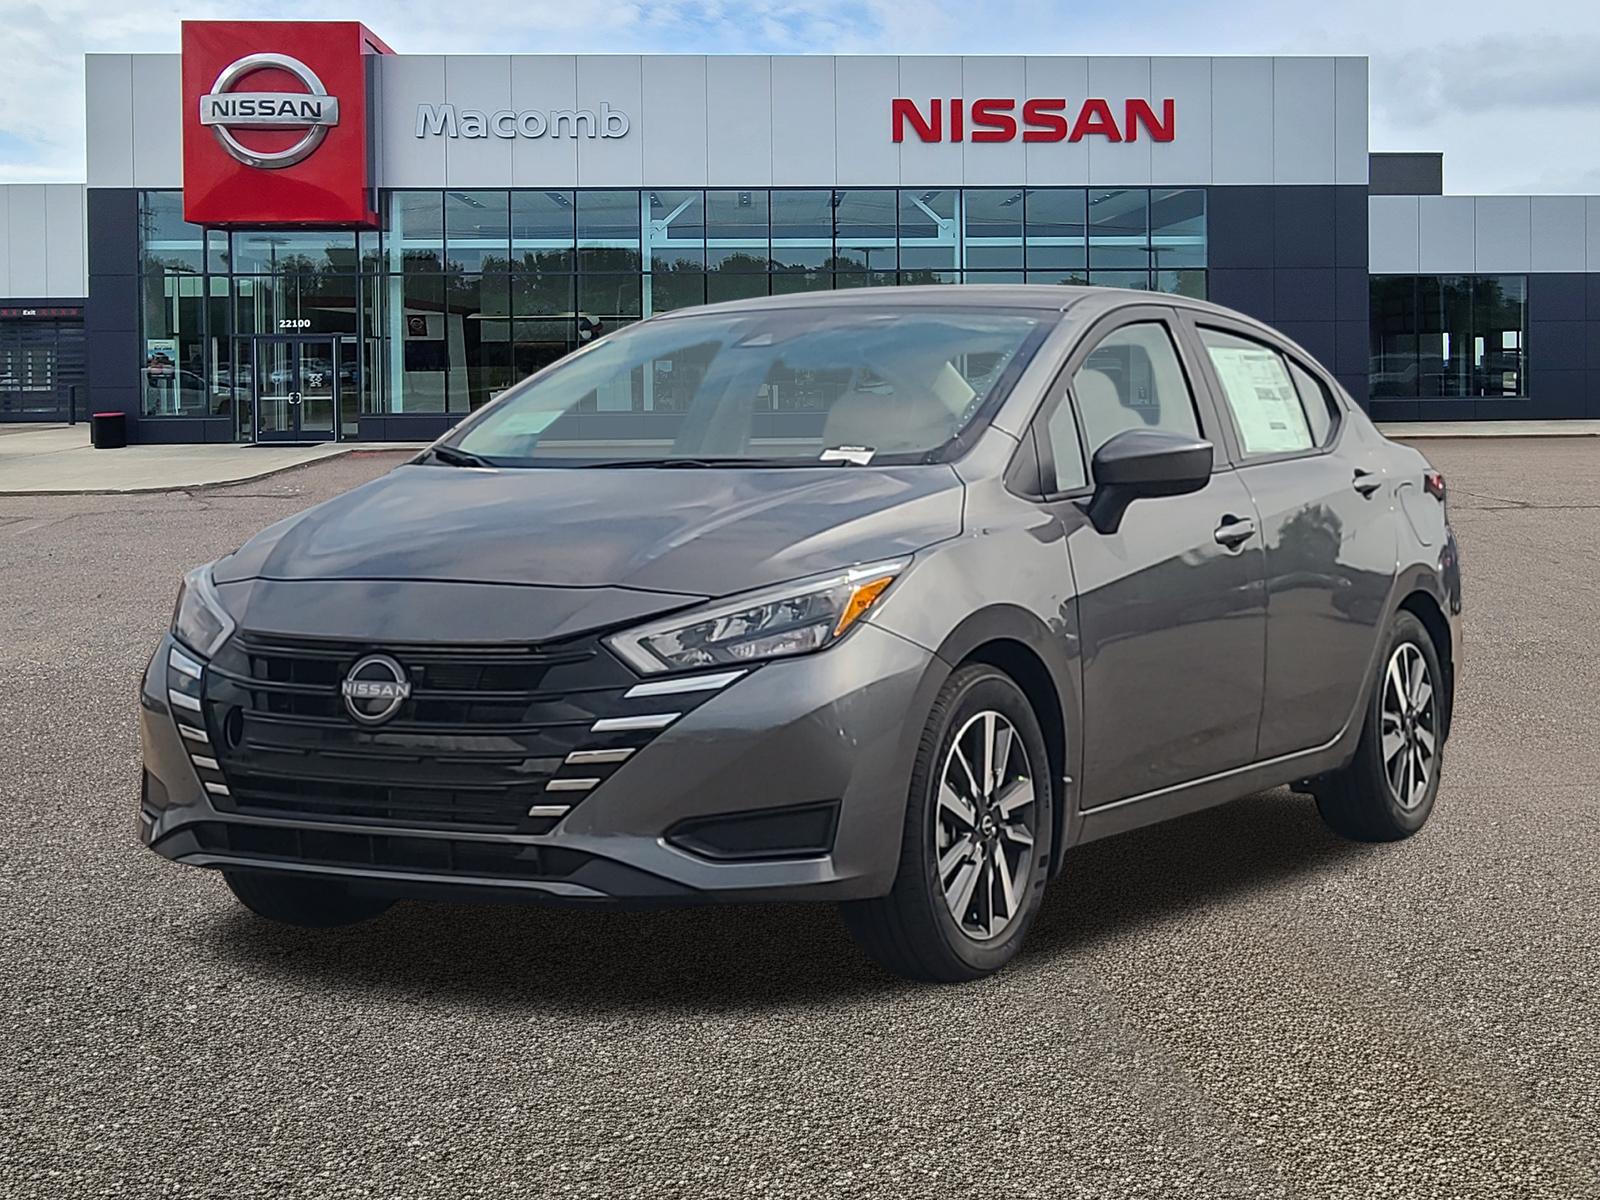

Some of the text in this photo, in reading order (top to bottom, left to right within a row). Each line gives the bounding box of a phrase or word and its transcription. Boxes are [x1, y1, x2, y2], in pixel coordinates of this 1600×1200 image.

[211, 100, 322, 118] NISSAN
[415, 102, 629, 138] Macomb
[892, 98, 1175, 143] NISSAN
[279, 319, 311, 328] 22100
[342, 682, 410, 697] NISSAN
